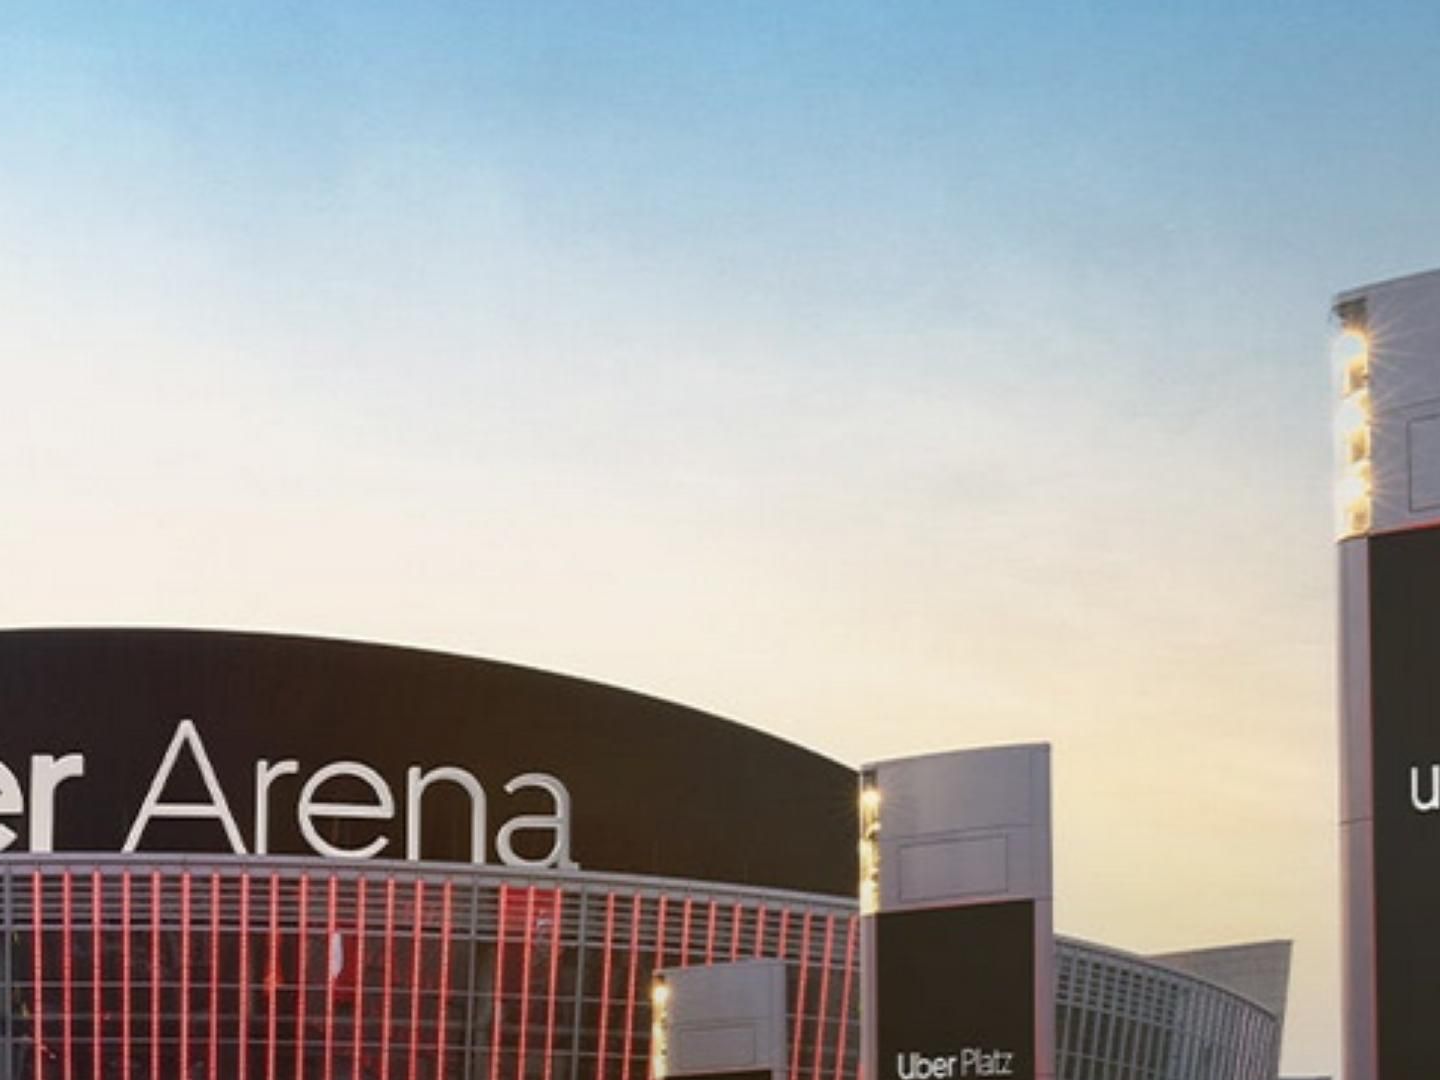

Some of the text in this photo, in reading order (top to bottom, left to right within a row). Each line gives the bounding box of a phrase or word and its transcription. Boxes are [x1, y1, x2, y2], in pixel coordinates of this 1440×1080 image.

[120, 719, 581, 869] Arena
[897, 1047, 1013, 1080] Uber Platz
